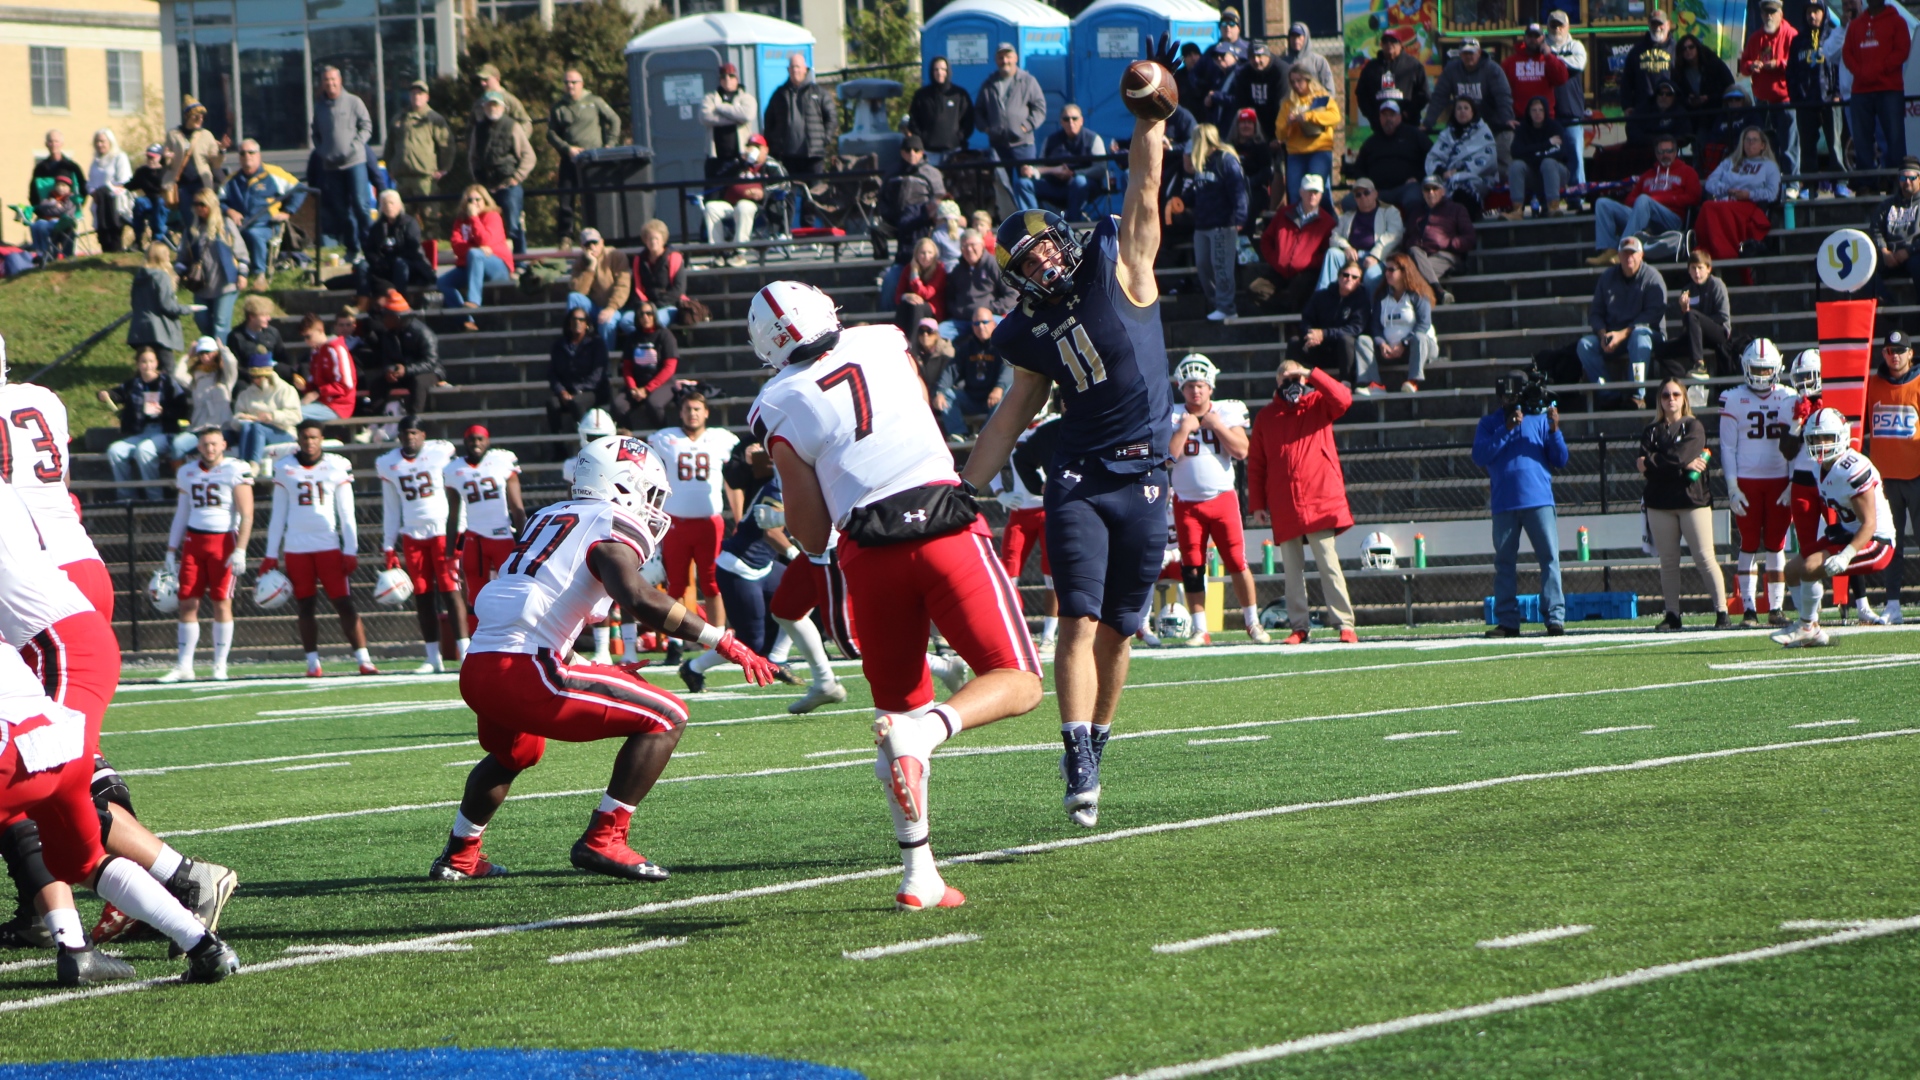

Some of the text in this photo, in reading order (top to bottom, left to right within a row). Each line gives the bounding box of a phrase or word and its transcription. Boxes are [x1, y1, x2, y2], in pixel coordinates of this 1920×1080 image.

[1050, 315, 1077, 340] SHEPHERD
[1056, 323, 1108, 393] 11
[815, 362, 873, 443] 7
[1746, 410, 1781, 439] 32
[1873, 413, 1915, 428] PSAC
[1184, 428, 1220, 456] 64
[678, 453, 710, 481] 68
[1840, 455, 1858, 470] 80
[191, 483, 221, 508] 56
[297, 481, 324, 505] 21
[398, 470, 434, 501] 52
[463, 476, 500, 504] 22
[507, 513, 580, 578] 47
